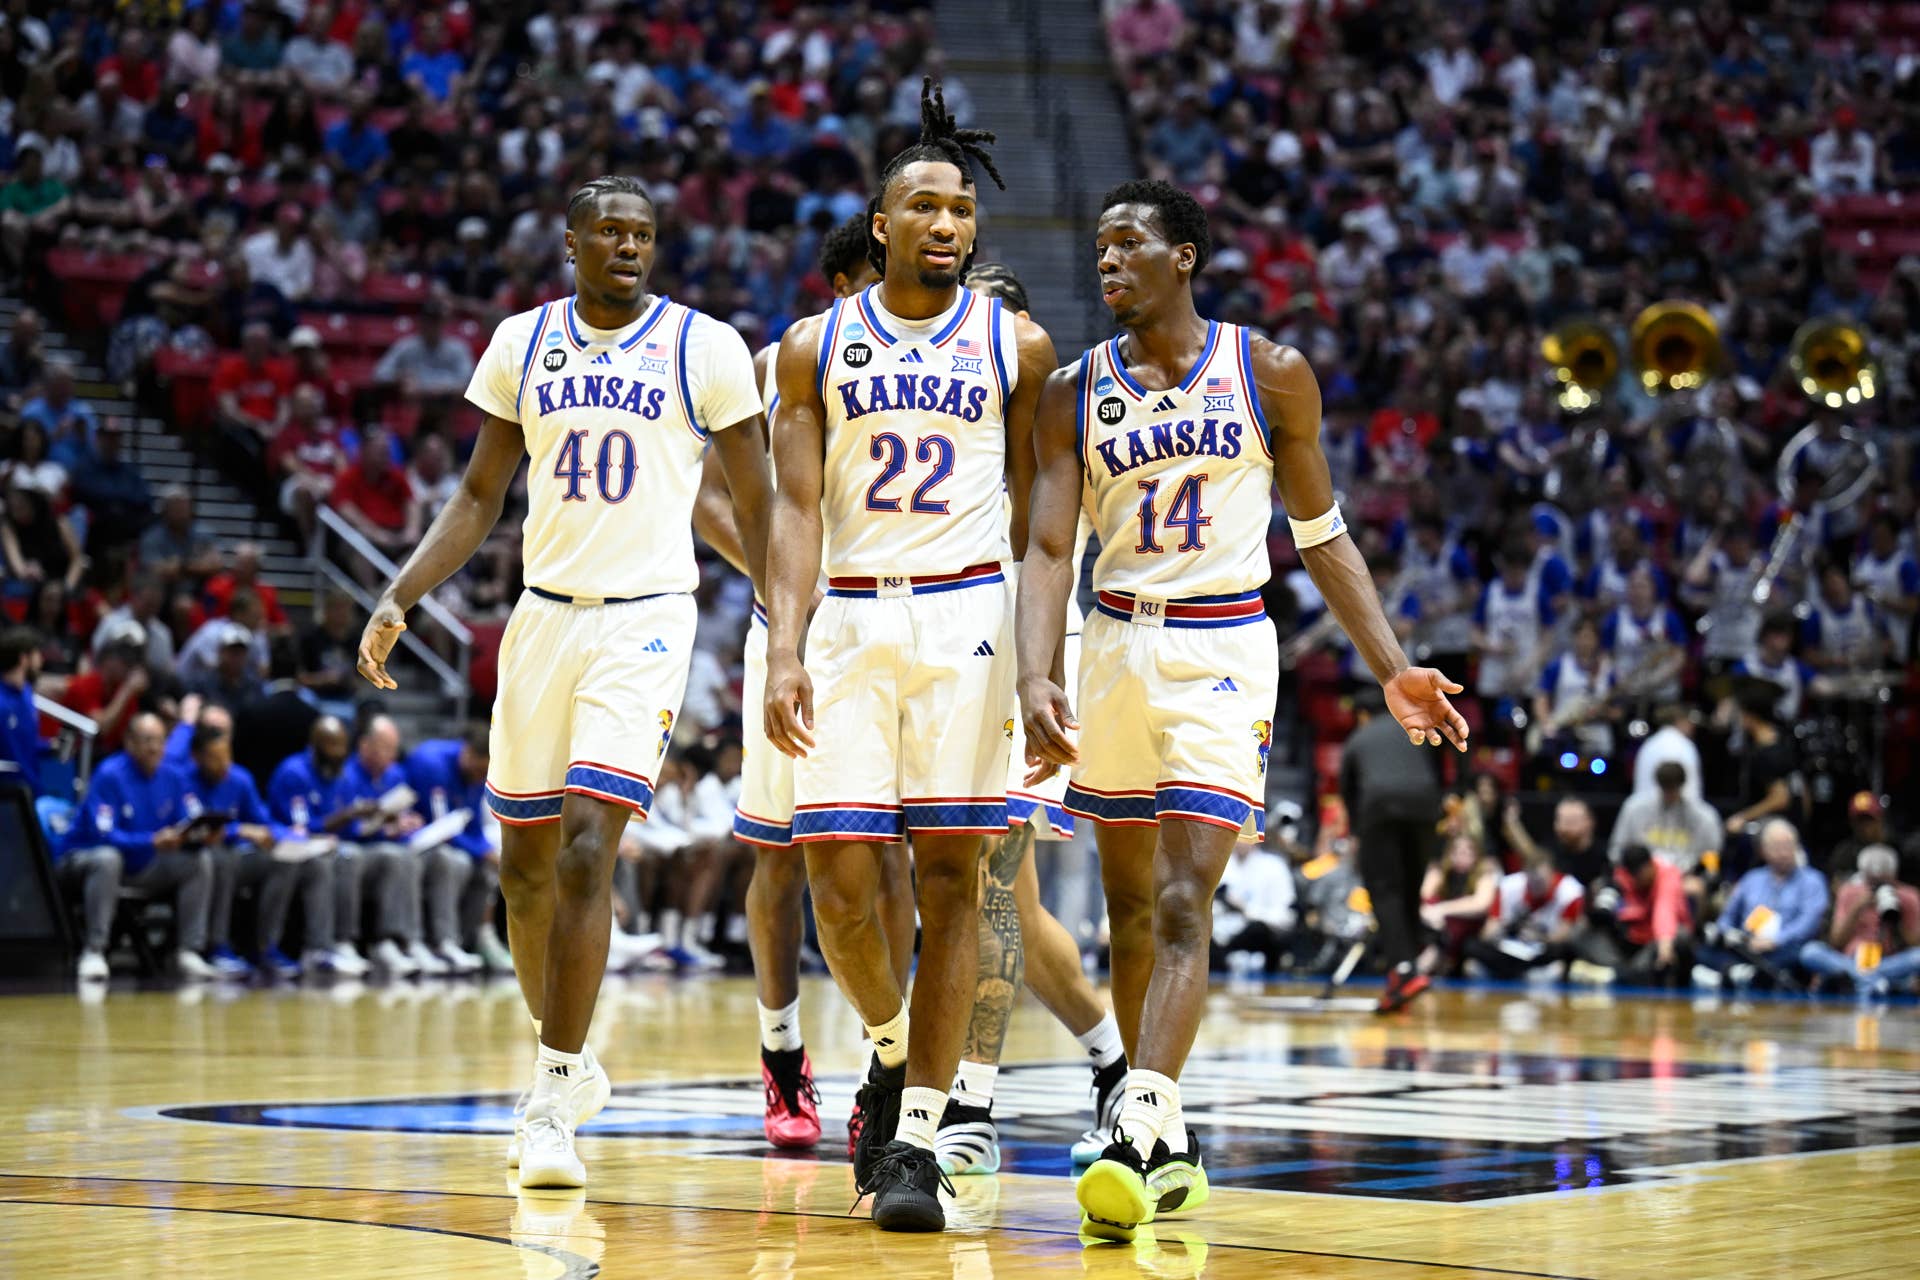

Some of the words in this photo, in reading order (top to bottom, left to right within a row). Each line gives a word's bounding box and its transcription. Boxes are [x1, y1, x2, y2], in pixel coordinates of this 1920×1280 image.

[545, 353, 565, 369] SW
[846, 348, 868, 362] SW
[535, 375, 666, 420] KANSAS
[837, 374, 988, 422] KANSAS
[1101, 402, 1121, 419] SW
[1096, 418, 1242, 478] KANSAS
[554, 428, 639, 504] 40
[866, 432, 956, 515] 22
[1135, 473, 1213, 554] 14
[884, 577, 903, 588] KU
[1140, 601, 1158, 616] KU
[991, 912, 1019, 930] NEVE
